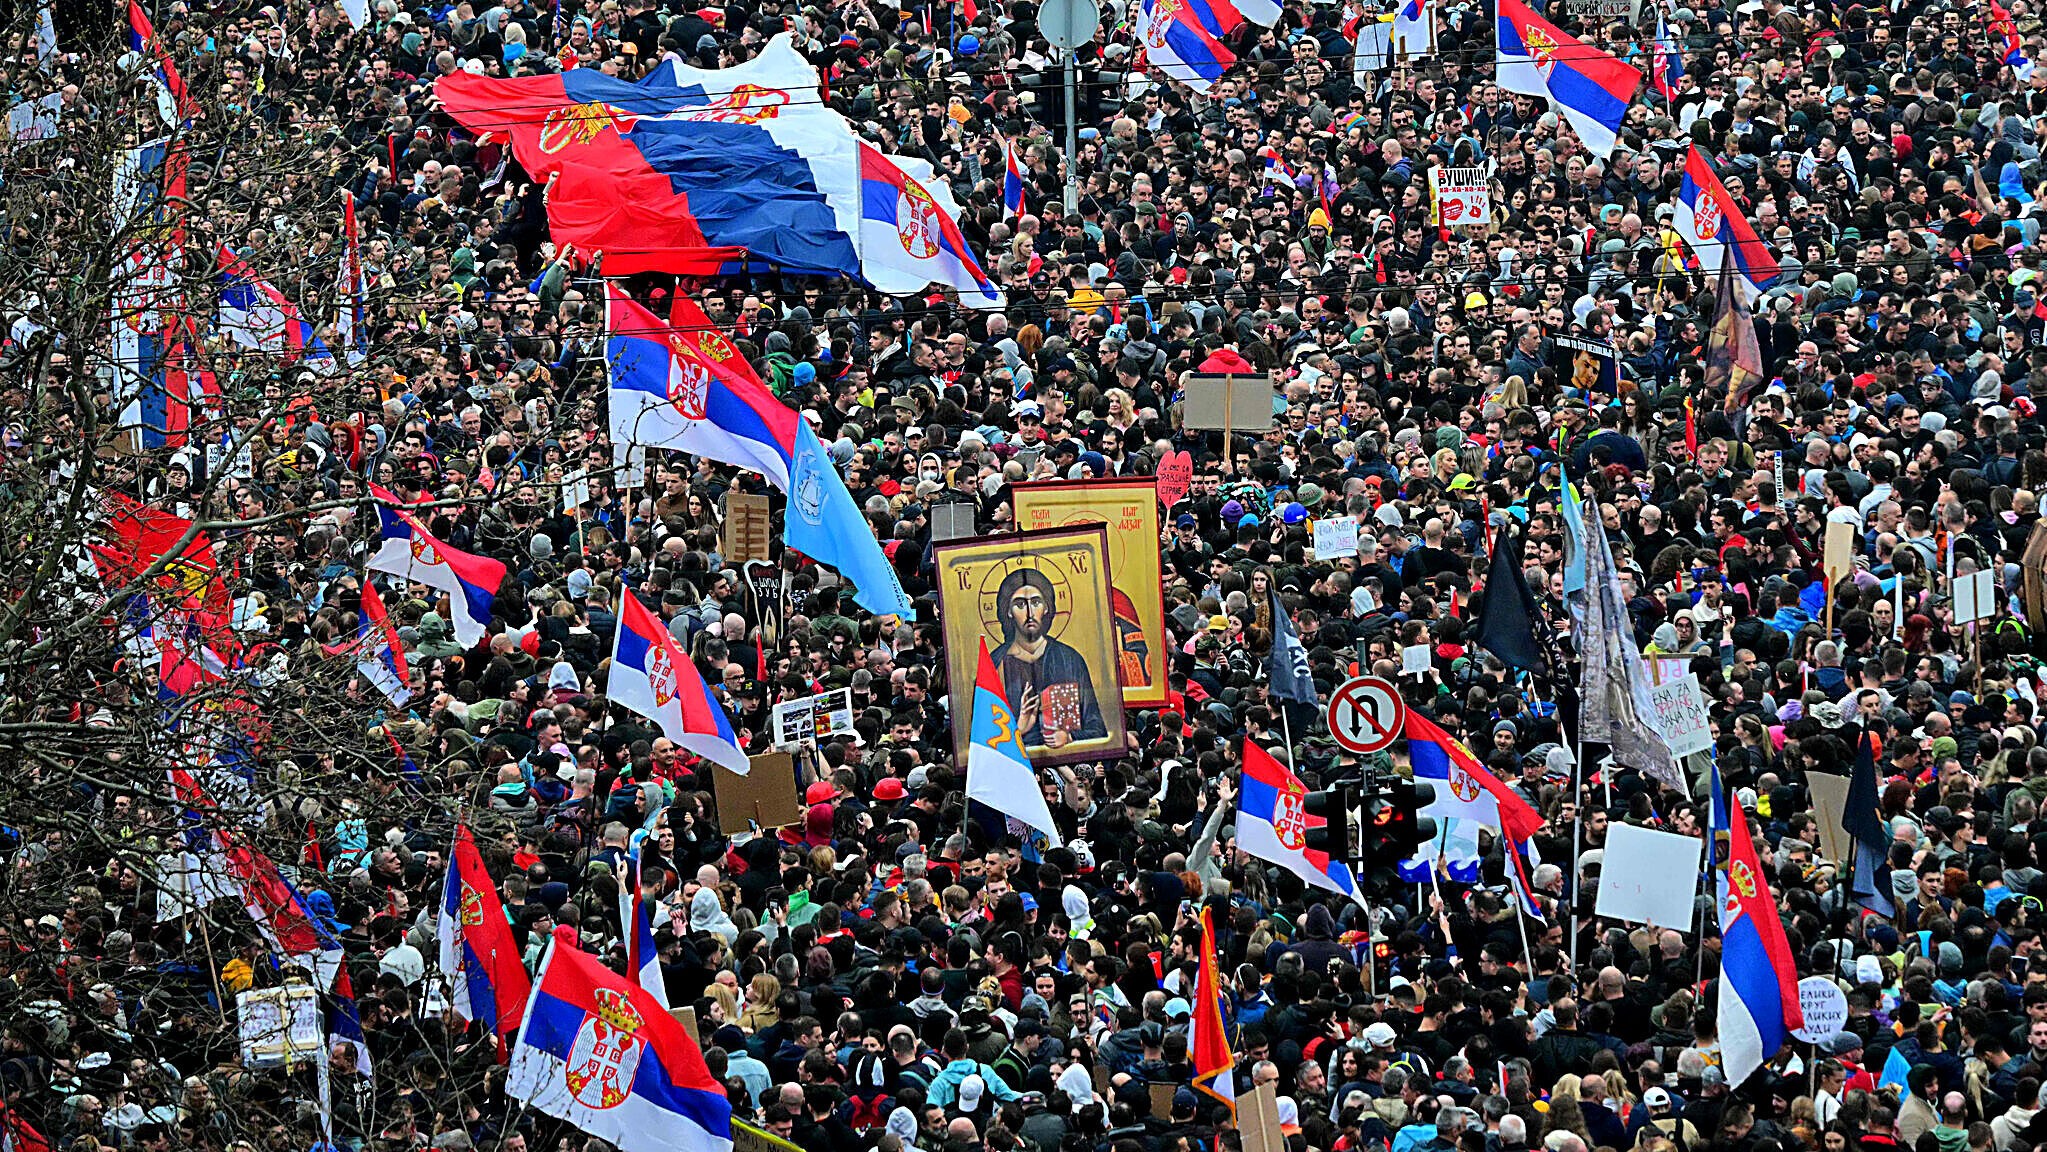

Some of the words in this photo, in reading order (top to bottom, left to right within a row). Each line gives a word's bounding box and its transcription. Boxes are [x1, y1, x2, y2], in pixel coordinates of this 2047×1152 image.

[758, 587, 778, 599] ЗУБ
[1800, 990, 1835, 1000] ЕЛИКИ
[1806, 1010, 1841, 1021] ЛИКИХ
